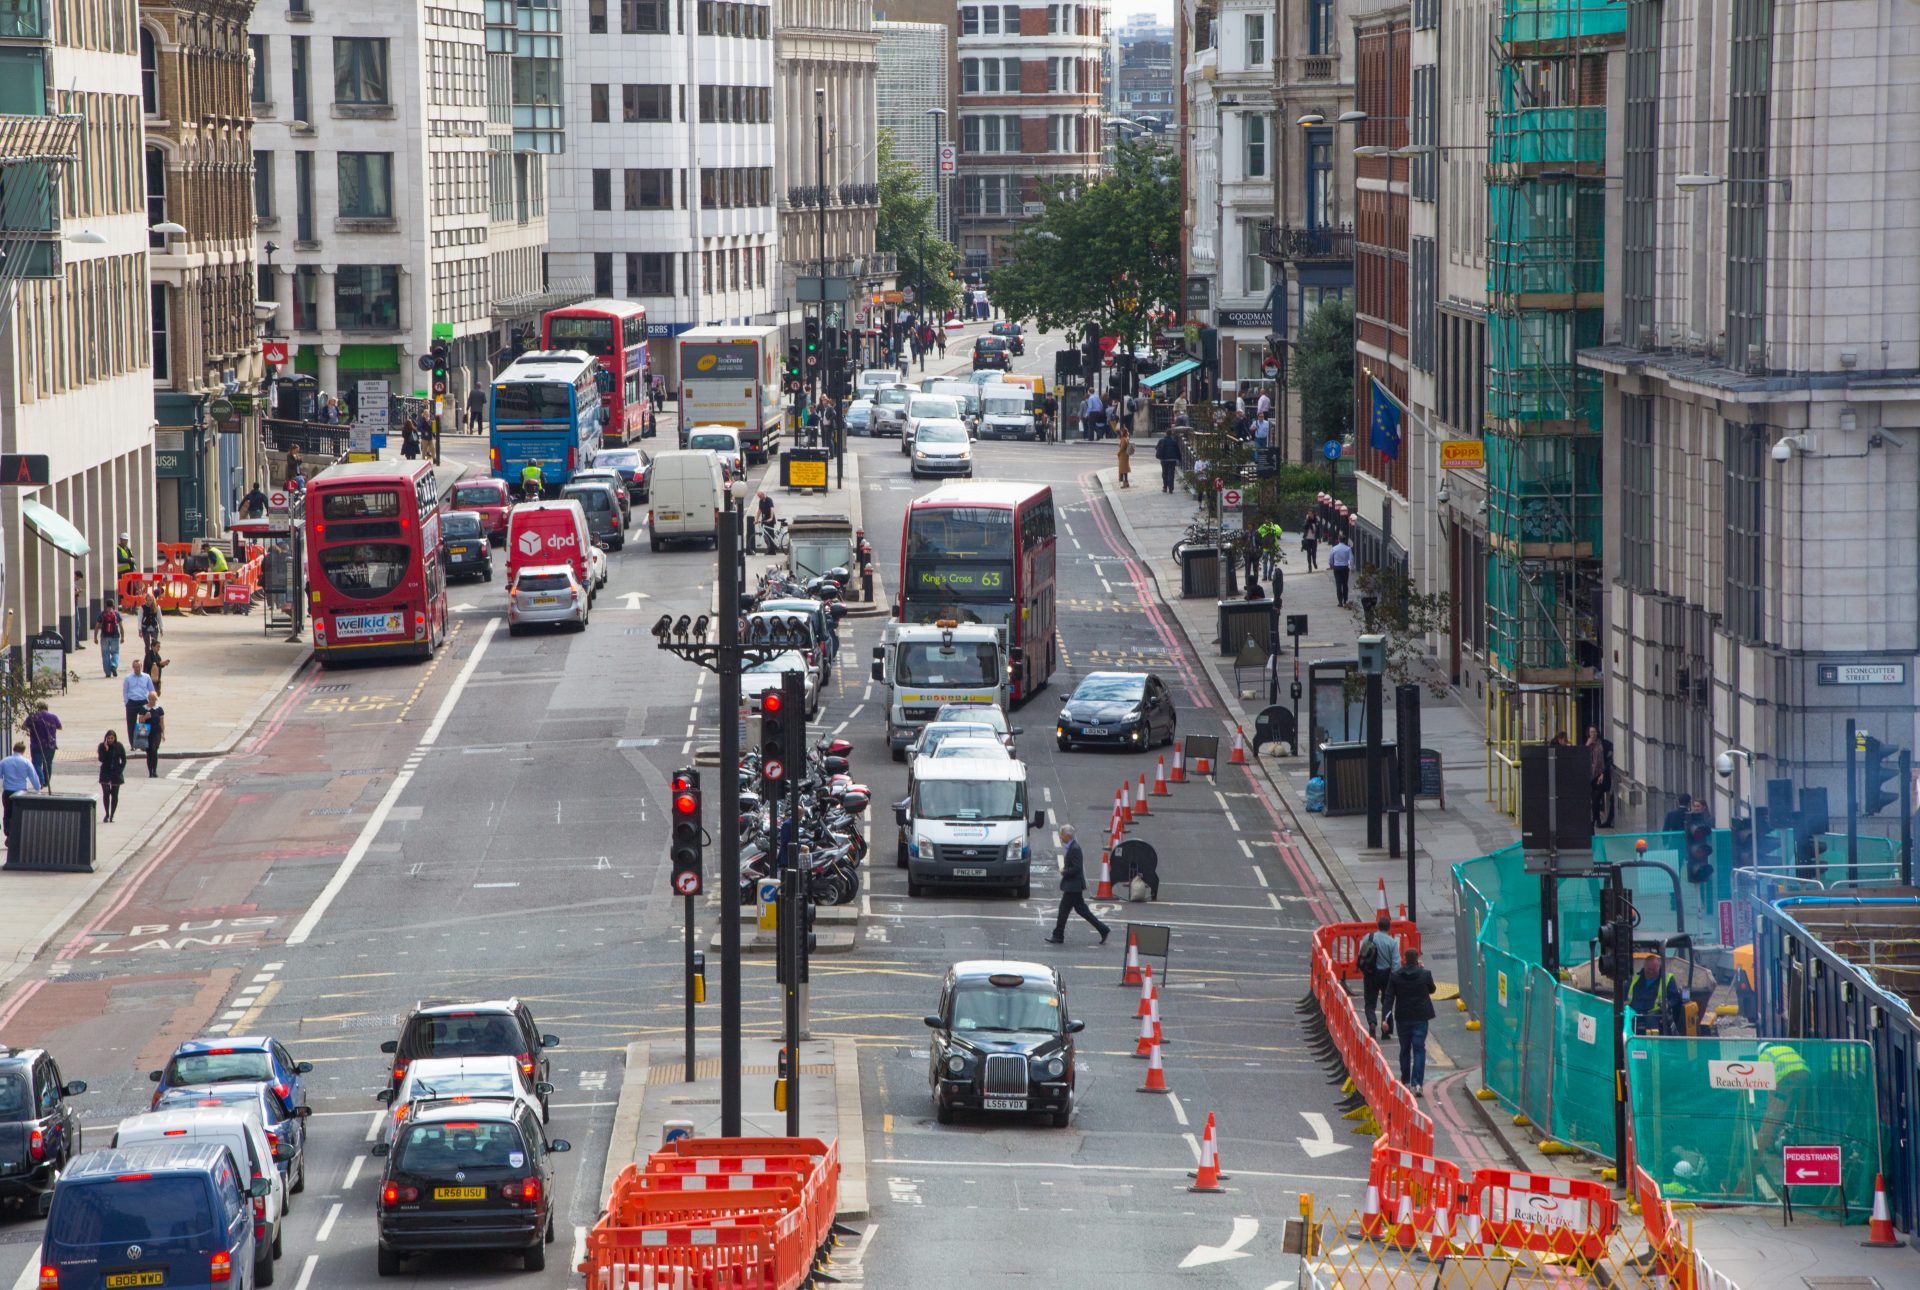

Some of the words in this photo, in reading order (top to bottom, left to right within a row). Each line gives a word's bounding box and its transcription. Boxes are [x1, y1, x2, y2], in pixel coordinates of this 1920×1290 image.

[1229, 313, 1273, 321] GOODMAN
[654, 325, 668, 334] RBS
[547, 532, 576, 550] dpd
[922, 573, 947, 586] King's
[949, 573, 973, 583] Cross
[981, 572, 1000, 586] 63
[337, 616, 385, 630] wellkid
[312, 694, 397, 706] BUS
[129, 916, 278, 936] BUS
[90, 930, 268, 954] LANE
[1715, 1075, 1770, 1089] ReachActive
[986, 1099, 1007, 1108] LS56
[1009, 1100, 1024, 1109] VDX
[1786, 1152, 1839, 1161] PEDESTRIANS
[438, 1187, 462, 1198] LR58
[463, 1187, 482, 1198] USU
[108, 1275, 139, 1287] LB08
